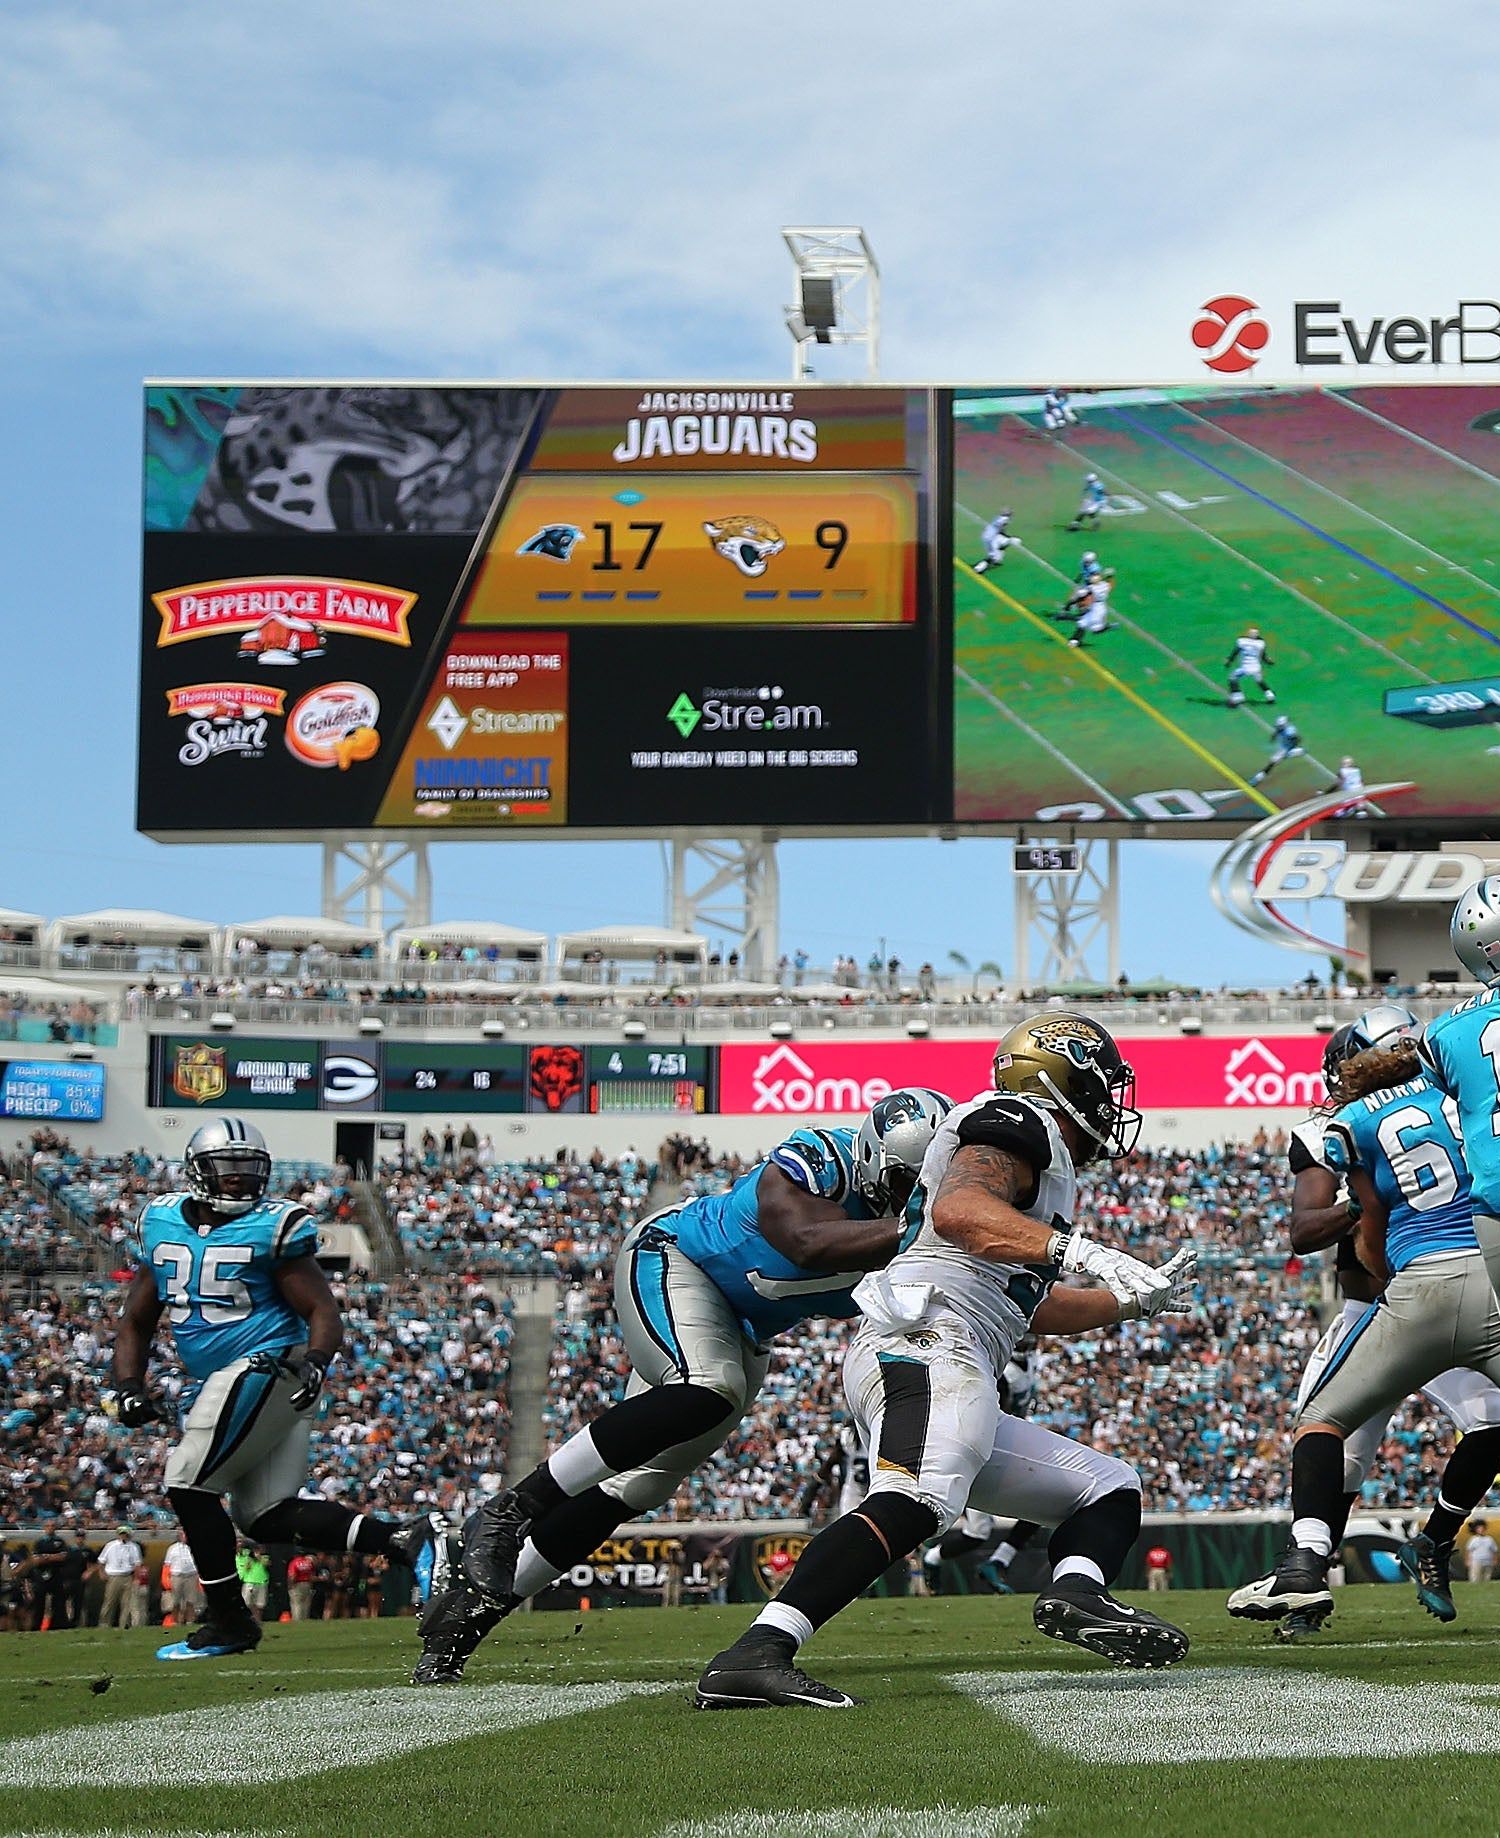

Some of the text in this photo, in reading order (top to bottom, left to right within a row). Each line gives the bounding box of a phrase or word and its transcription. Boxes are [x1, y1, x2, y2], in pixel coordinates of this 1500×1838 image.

[638, 392, 795, 413] JACKSONVILLE
[612, 415, 819, 464] JAGUARS
[591, 519, 665, 572] 17
[814, 518, 849, 570] 9
[178, 587, 391, 628] PEPPERIDGE FARM
[446, 654, 530, 671] DOWNLOAD
[446, 672, 519, 688] FREE APP
[1414, 691, 1486, 715] 3RD
[471, 706, 558, 734] Stream
[178, 716, 269, 766] Swirl
[1029, 848, 1078, 869] 9:51
[1252, 842, 1488, 902] BUD
[236, 1060, 287, 1078] AROUND
[607, 1051, 624, 1075] 4
[5, 1081, 51, 1098] HIGH
[751, 1077, 893, 1112] xome
[1224, 1071, 1327, 1106] xom
[4, 1096, 62, 1116] PRECIP
[152, 1241, 255, 1325] 35
